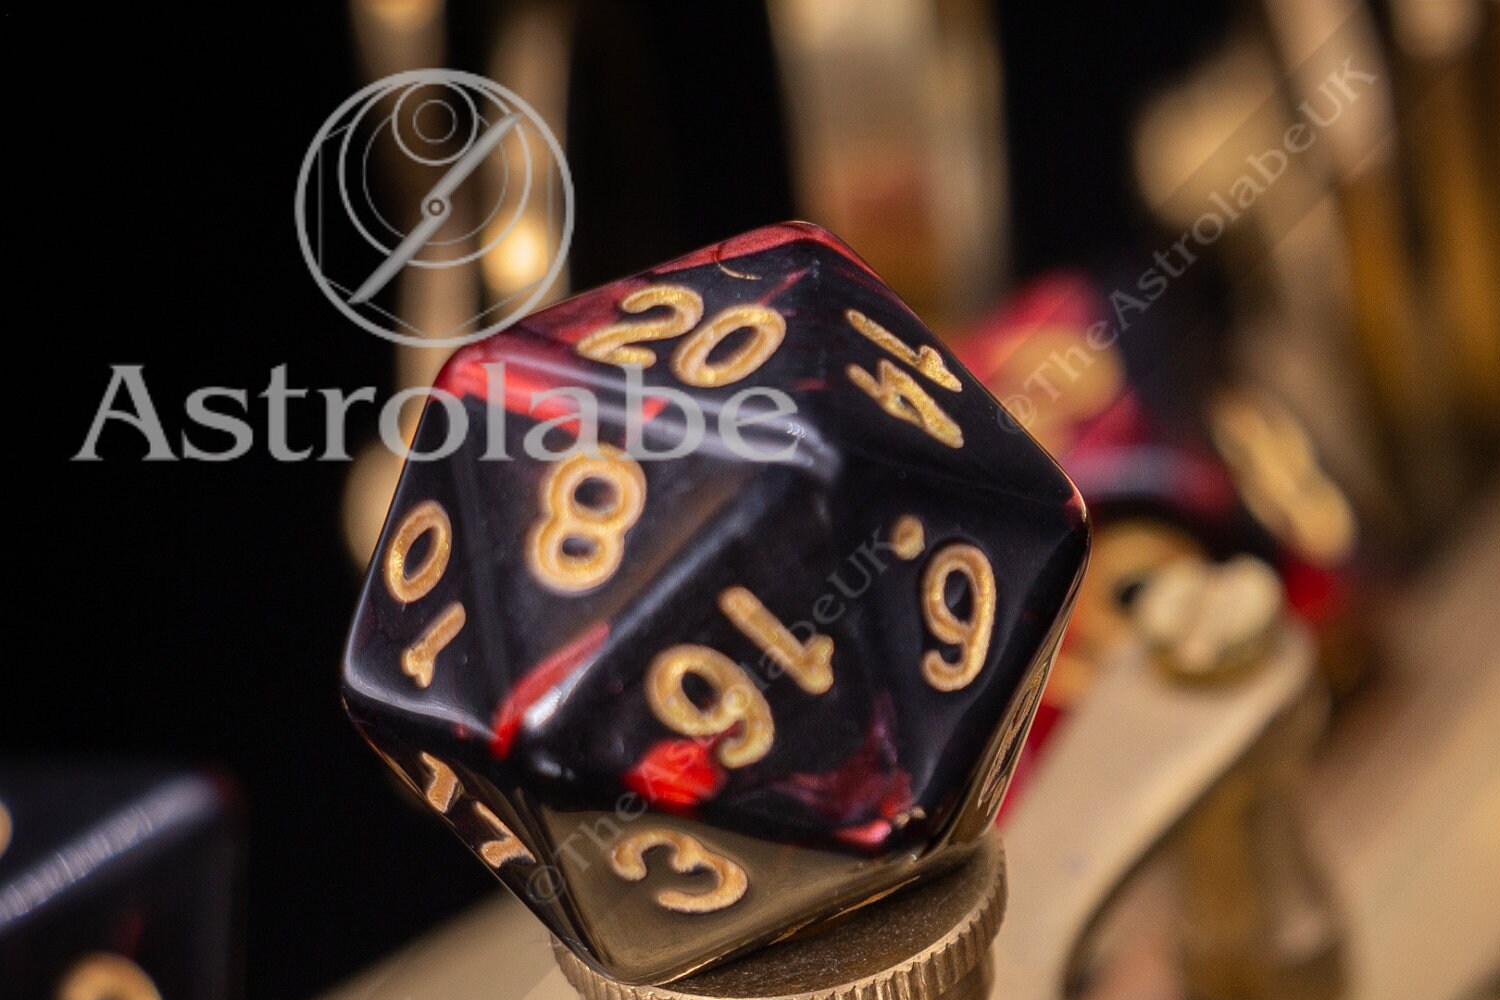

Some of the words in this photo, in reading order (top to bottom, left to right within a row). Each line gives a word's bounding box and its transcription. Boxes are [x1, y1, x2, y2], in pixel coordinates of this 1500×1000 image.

[577, 285, 786, 389] 20
[846, 309, 963, 449] 14
[526, 442, 646, 594] 8
[383, 501, 466, 689] 10
[644, 584, 835, 769] 16
[610, 828, 749, 913] 3
